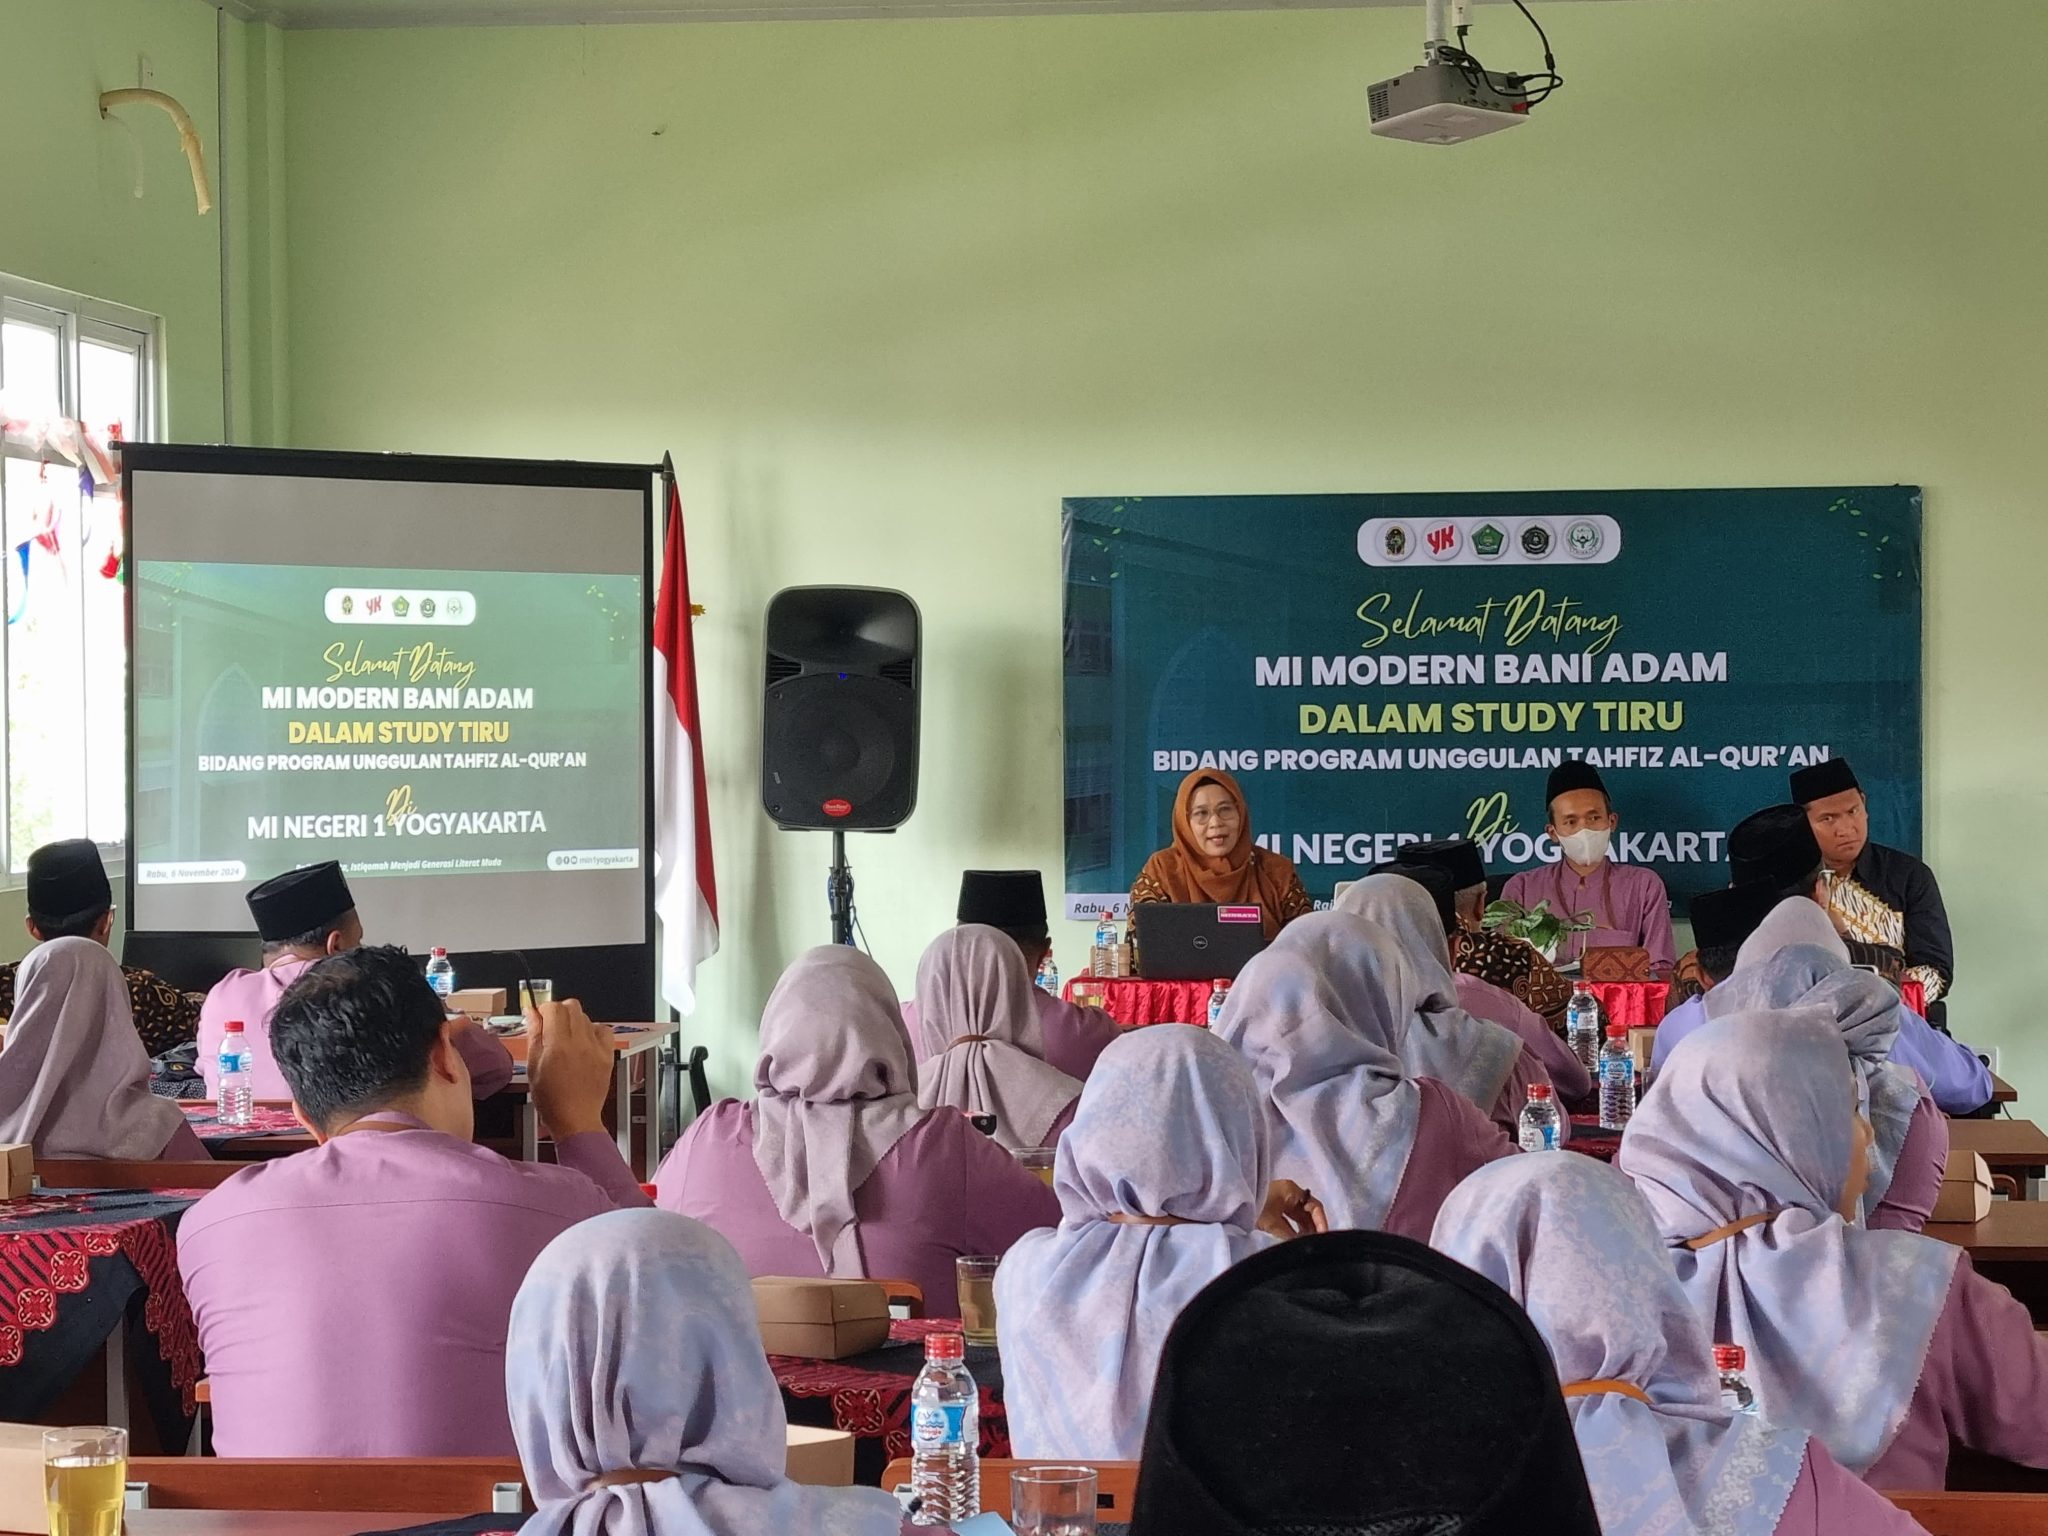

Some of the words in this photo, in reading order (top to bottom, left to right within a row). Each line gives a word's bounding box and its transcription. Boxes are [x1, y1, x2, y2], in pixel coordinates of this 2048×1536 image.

[1356, 588, 1504, 648] Selamat
[1503, 588, 1624, 657] Datang
[323, 640, 410, 682] Selamat
[409, 641, 476, 691] Datang
[1255, 656, 1302, 686] MI
[1312, 654, 1485, 685] MODERN
[1495, 653, 1592, 684] BANI
[1601, 652, 1727, 683] ADAM
[262, 687, 291, 709] MI
[297, 687, 398, 709] MODERN
[404, 688, 459, 709] BANI
[464, 688, 533, 709] ADAM
[1300, 703, 1442, 734] DALAM
[1451, 702, 1585, 733] STUDY
[1593, 701, 1683, 731] TIRU
[289, 722, 373, 744] DALAM
[379, 721, 454, 743] STUDY
[459, 721, 509, 743] TIRU
[199, 755, 264, 771] BIDANG
[267, 754, 350, 771] PROGRAM
[353, 753, 441, 770] UNGGULAN
[444, 753, 498, 769] TAHFIZ
[1153, 750, 1258, 771] BIDANG
[1264, 749, 1402, 770] PROGRAM
[1408, 748, 1561, 769] UNGGULAN
[1567, 747, 1663, 768] TAHFIZ
[386, 784, 417, 826] Di
[248, 816, 277, 839] MI
[284, 814, 367, 838] NEGERI
[373, 814, 386, 837] 1
[393, 810, 547, 836] YOGYAKARTA
[1466, 791, 1520, 848] Di
[1293, 833, 1432, 864] NEGE
[1474, 832, 1730, 864] YOGKART
[178, 867, 218, 878] November
[220, 867, 239, 876] 2024
[481, 858, 502, 867] Muda
[1113, 903, 1120, 913] 6
[1313, 899, 1334, 911] Rai
